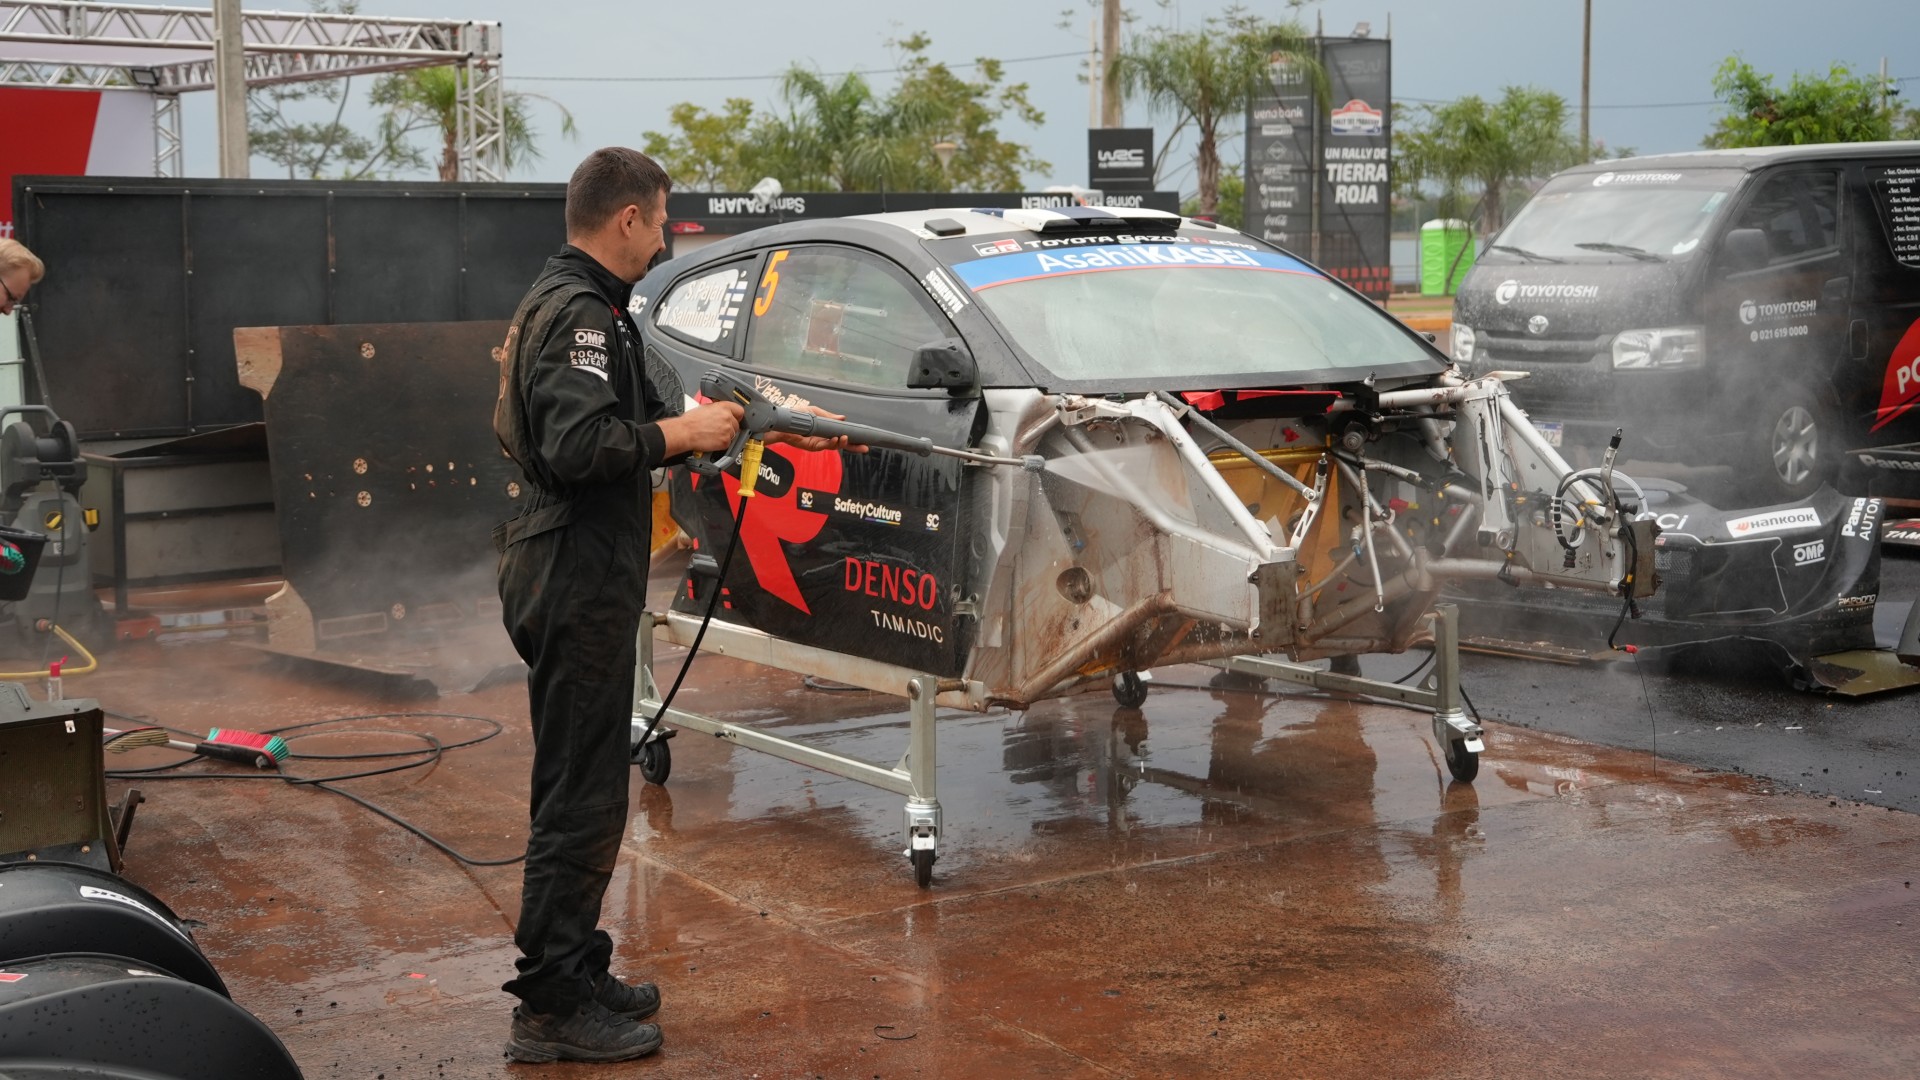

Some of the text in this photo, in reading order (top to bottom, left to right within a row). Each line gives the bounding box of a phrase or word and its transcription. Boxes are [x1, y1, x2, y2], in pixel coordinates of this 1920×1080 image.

[1097, 149, 1145, 162] WRC
[1325, 147, 1387, 160] UN RALLY DE
[1325, 163, 1388, 182] TIERRA
[1335, 184, 1378, 204] ROJA
[708, 197, 766, 214] PAJARI
[978, 234, 1258, 256] GR TOYOTA GAZOO Racing
[1036, 246, 1262, 272] AsahiKASEI
[753, 250, 790, 317] 5
[1520, 284, 1599, 298] TOYOTOSHI
[921, 279, 953, 318] RACING
[1758, 299, 1817, 316] TOYOTOSHI
[574, 331, 606, 346] OMP
[1760, 325, 1808, 340] 021 619 0000
[569, 350, 608, 364] POCARI
[570, 357, 606, 369] SWEAT
[801, 491, 939, 528] SC SafetyCulture SC
[1841, 497, 1867, 537] Pana
[1794, 543, 1825, 562] OMP
[844, 556, 937, 610] DENSO
[871, 609, 944, 644] TAMADIC
